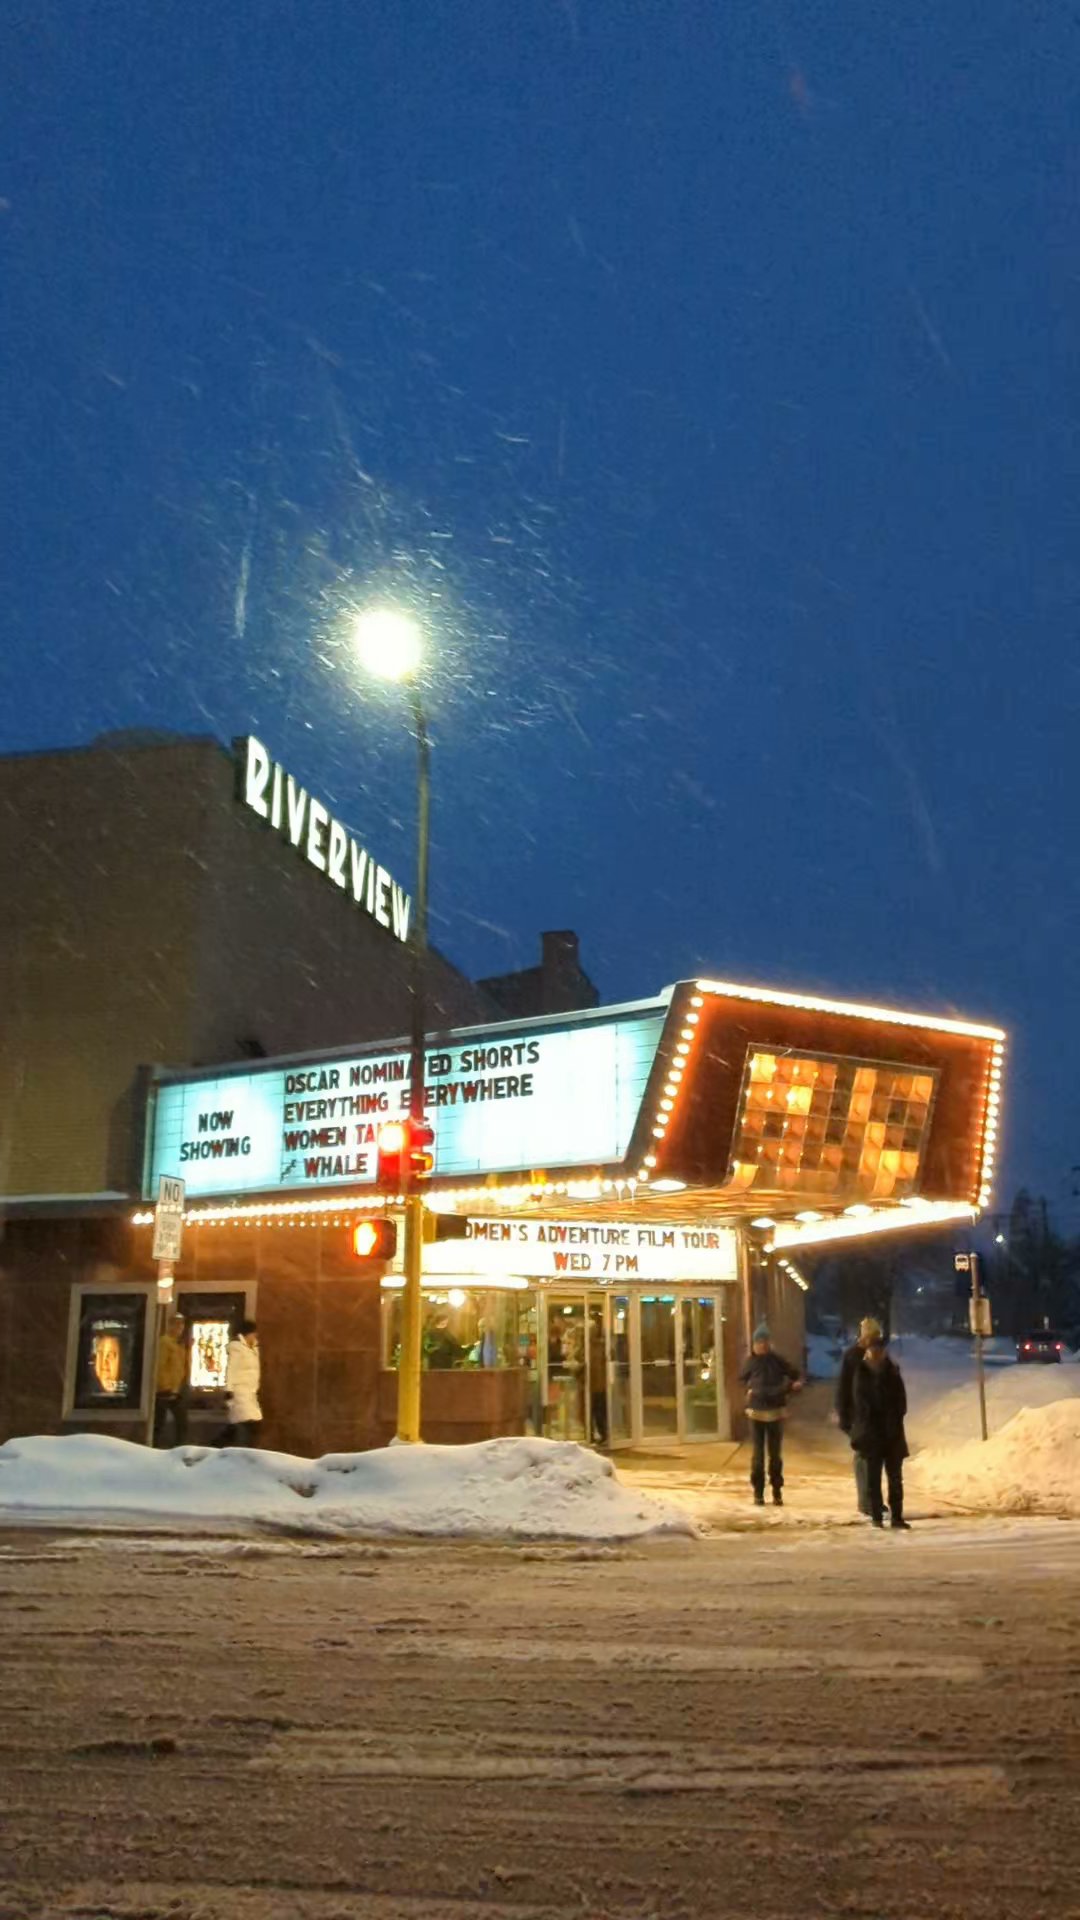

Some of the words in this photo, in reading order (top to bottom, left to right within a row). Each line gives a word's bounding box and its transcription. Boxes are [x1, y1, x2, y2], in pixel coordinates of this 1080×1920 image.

[246, 735, 410, 942] RIVERVIEW
[285, 1069, 340, 1095] OSCAR
[349, 1054, 452, 1087] NOMINED
[459, 1041, 540, 1073] SHORTS
[284, 1091, 389, 1124] EVERYTHING
[400, 1073, 533, 1110] EERYWHERE
[198, 1110, 234, 1133] NOW
[179, 1136, 251, 1162] SHOWING
[284, 1126, 347, 1152] WOMEN
[304, 1152, 368, 1178] WHALE
[163, 1181, 181, 1202] NO
[464, 1221, 529, 1242] OMEN'S
[537, 1225, 630, 1246] ADVENTURE
[637, 1230, 675, 1249] FILM
[681, 1232, 720, 1250] TOUR
[552, 1251, 592, 1272] WED
[602, 1253, 611, 1272] 7
[615, 1254, 639, 1273] PM
